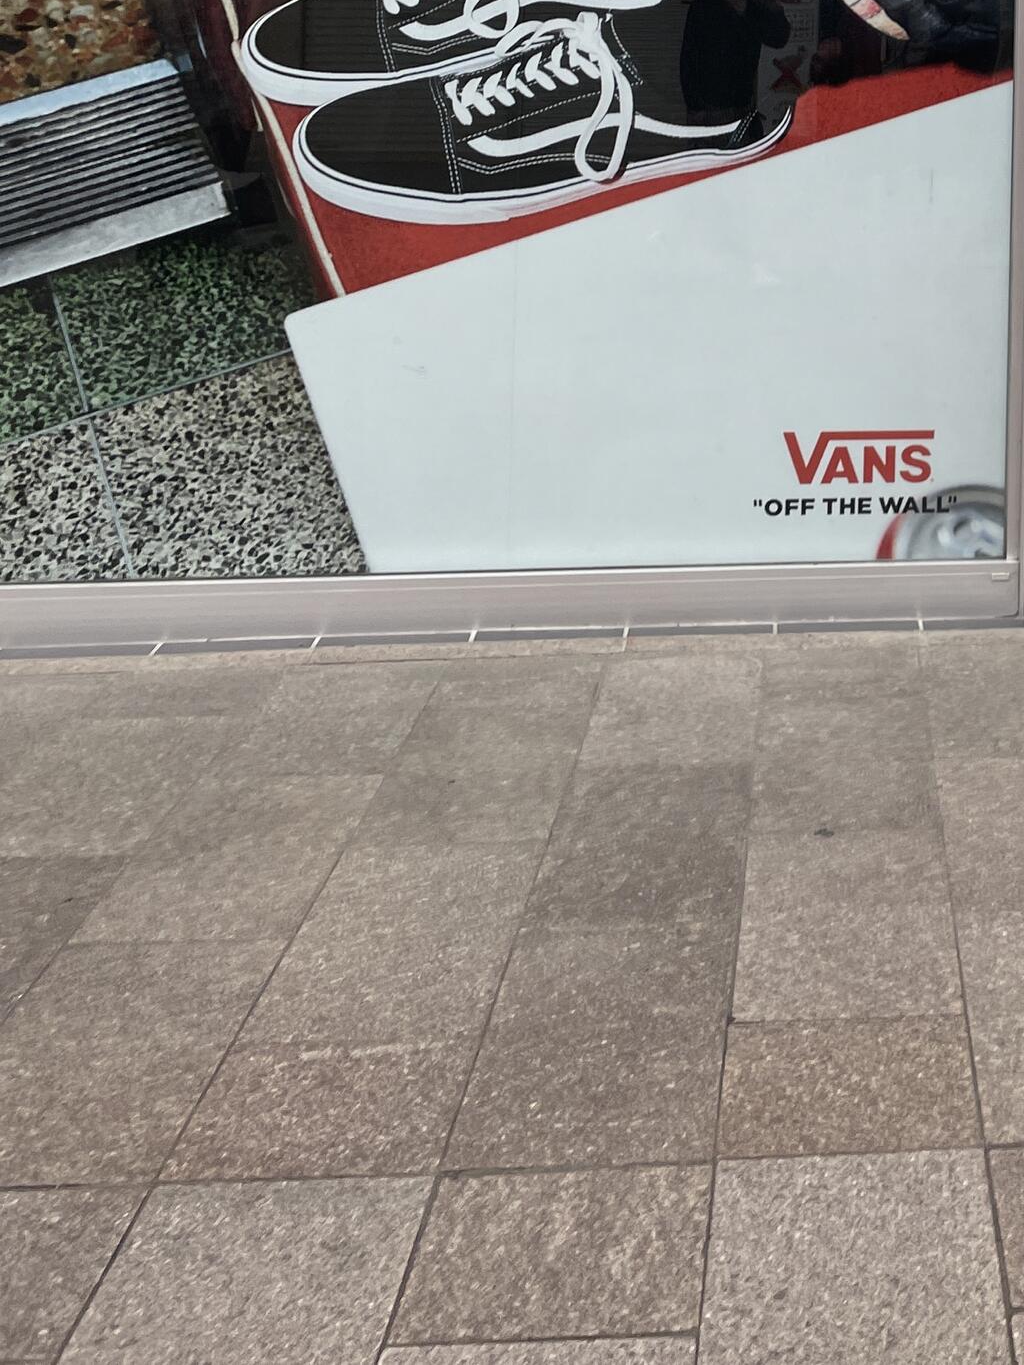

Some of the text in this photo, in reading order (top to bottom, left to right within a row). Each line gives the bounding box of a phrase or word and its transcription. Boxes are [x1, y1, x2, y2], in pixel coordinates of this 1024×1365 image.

[783, 430, 935, 485] VANS
[753, 494, 958, 517] "OFF THE WALL"
